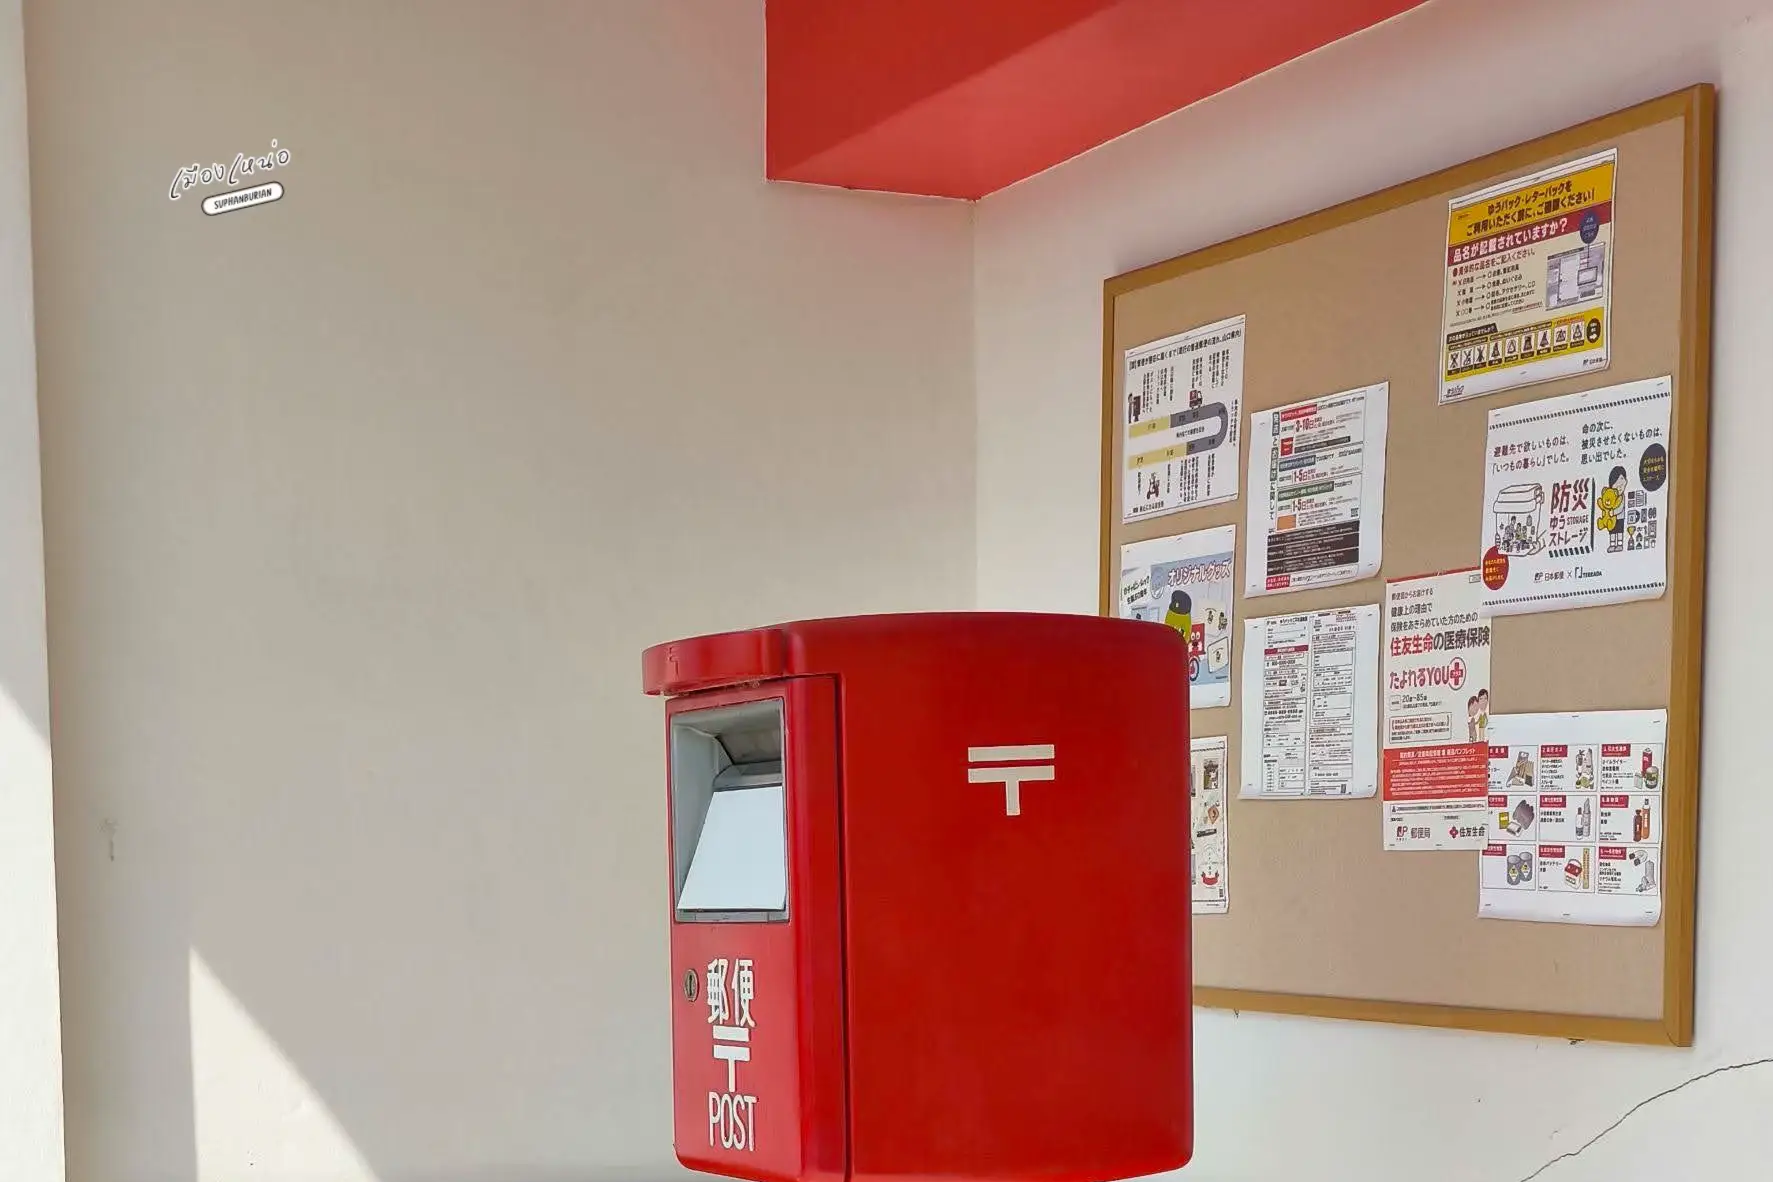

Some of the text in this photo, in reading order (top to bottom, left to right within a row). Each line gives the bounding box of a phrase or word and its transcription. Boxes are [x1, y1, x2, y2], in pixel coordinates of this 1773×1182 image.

[1581, 421, 1614, 435] 命の次に、
[1493, 435, 1570, 458] 避難先で欲しいものは、
[1581, 428, 1663, 450] 被災させたくないものは、
[1491, 455, 1570, 475] 「いつもの暮らし」でした。
[1580, 451, 1627, 465] 思い出でした。
[1550, 477, 1590, 515] 防災
[1550, 514, 1589, 531] ゆう STORAGE
[1549, 526, 1589, 547] ストレージ
[1167, 557, 1232, 587] オリジナルグッズ
[1391, 603, 1433, 618] 健康上の理由で
[1390, 612, 1478, 633] 保険をあきらめていた方のための
[1390, 625, 1490, 657] 住友生命の医療保険
[1410, 827, 1431, 839] 郵便局
[1459, 826, 1485, 837] 住友生命
[707, 958, 756, 1027] 郵便
[708, 1091, 758, 1151] POST
